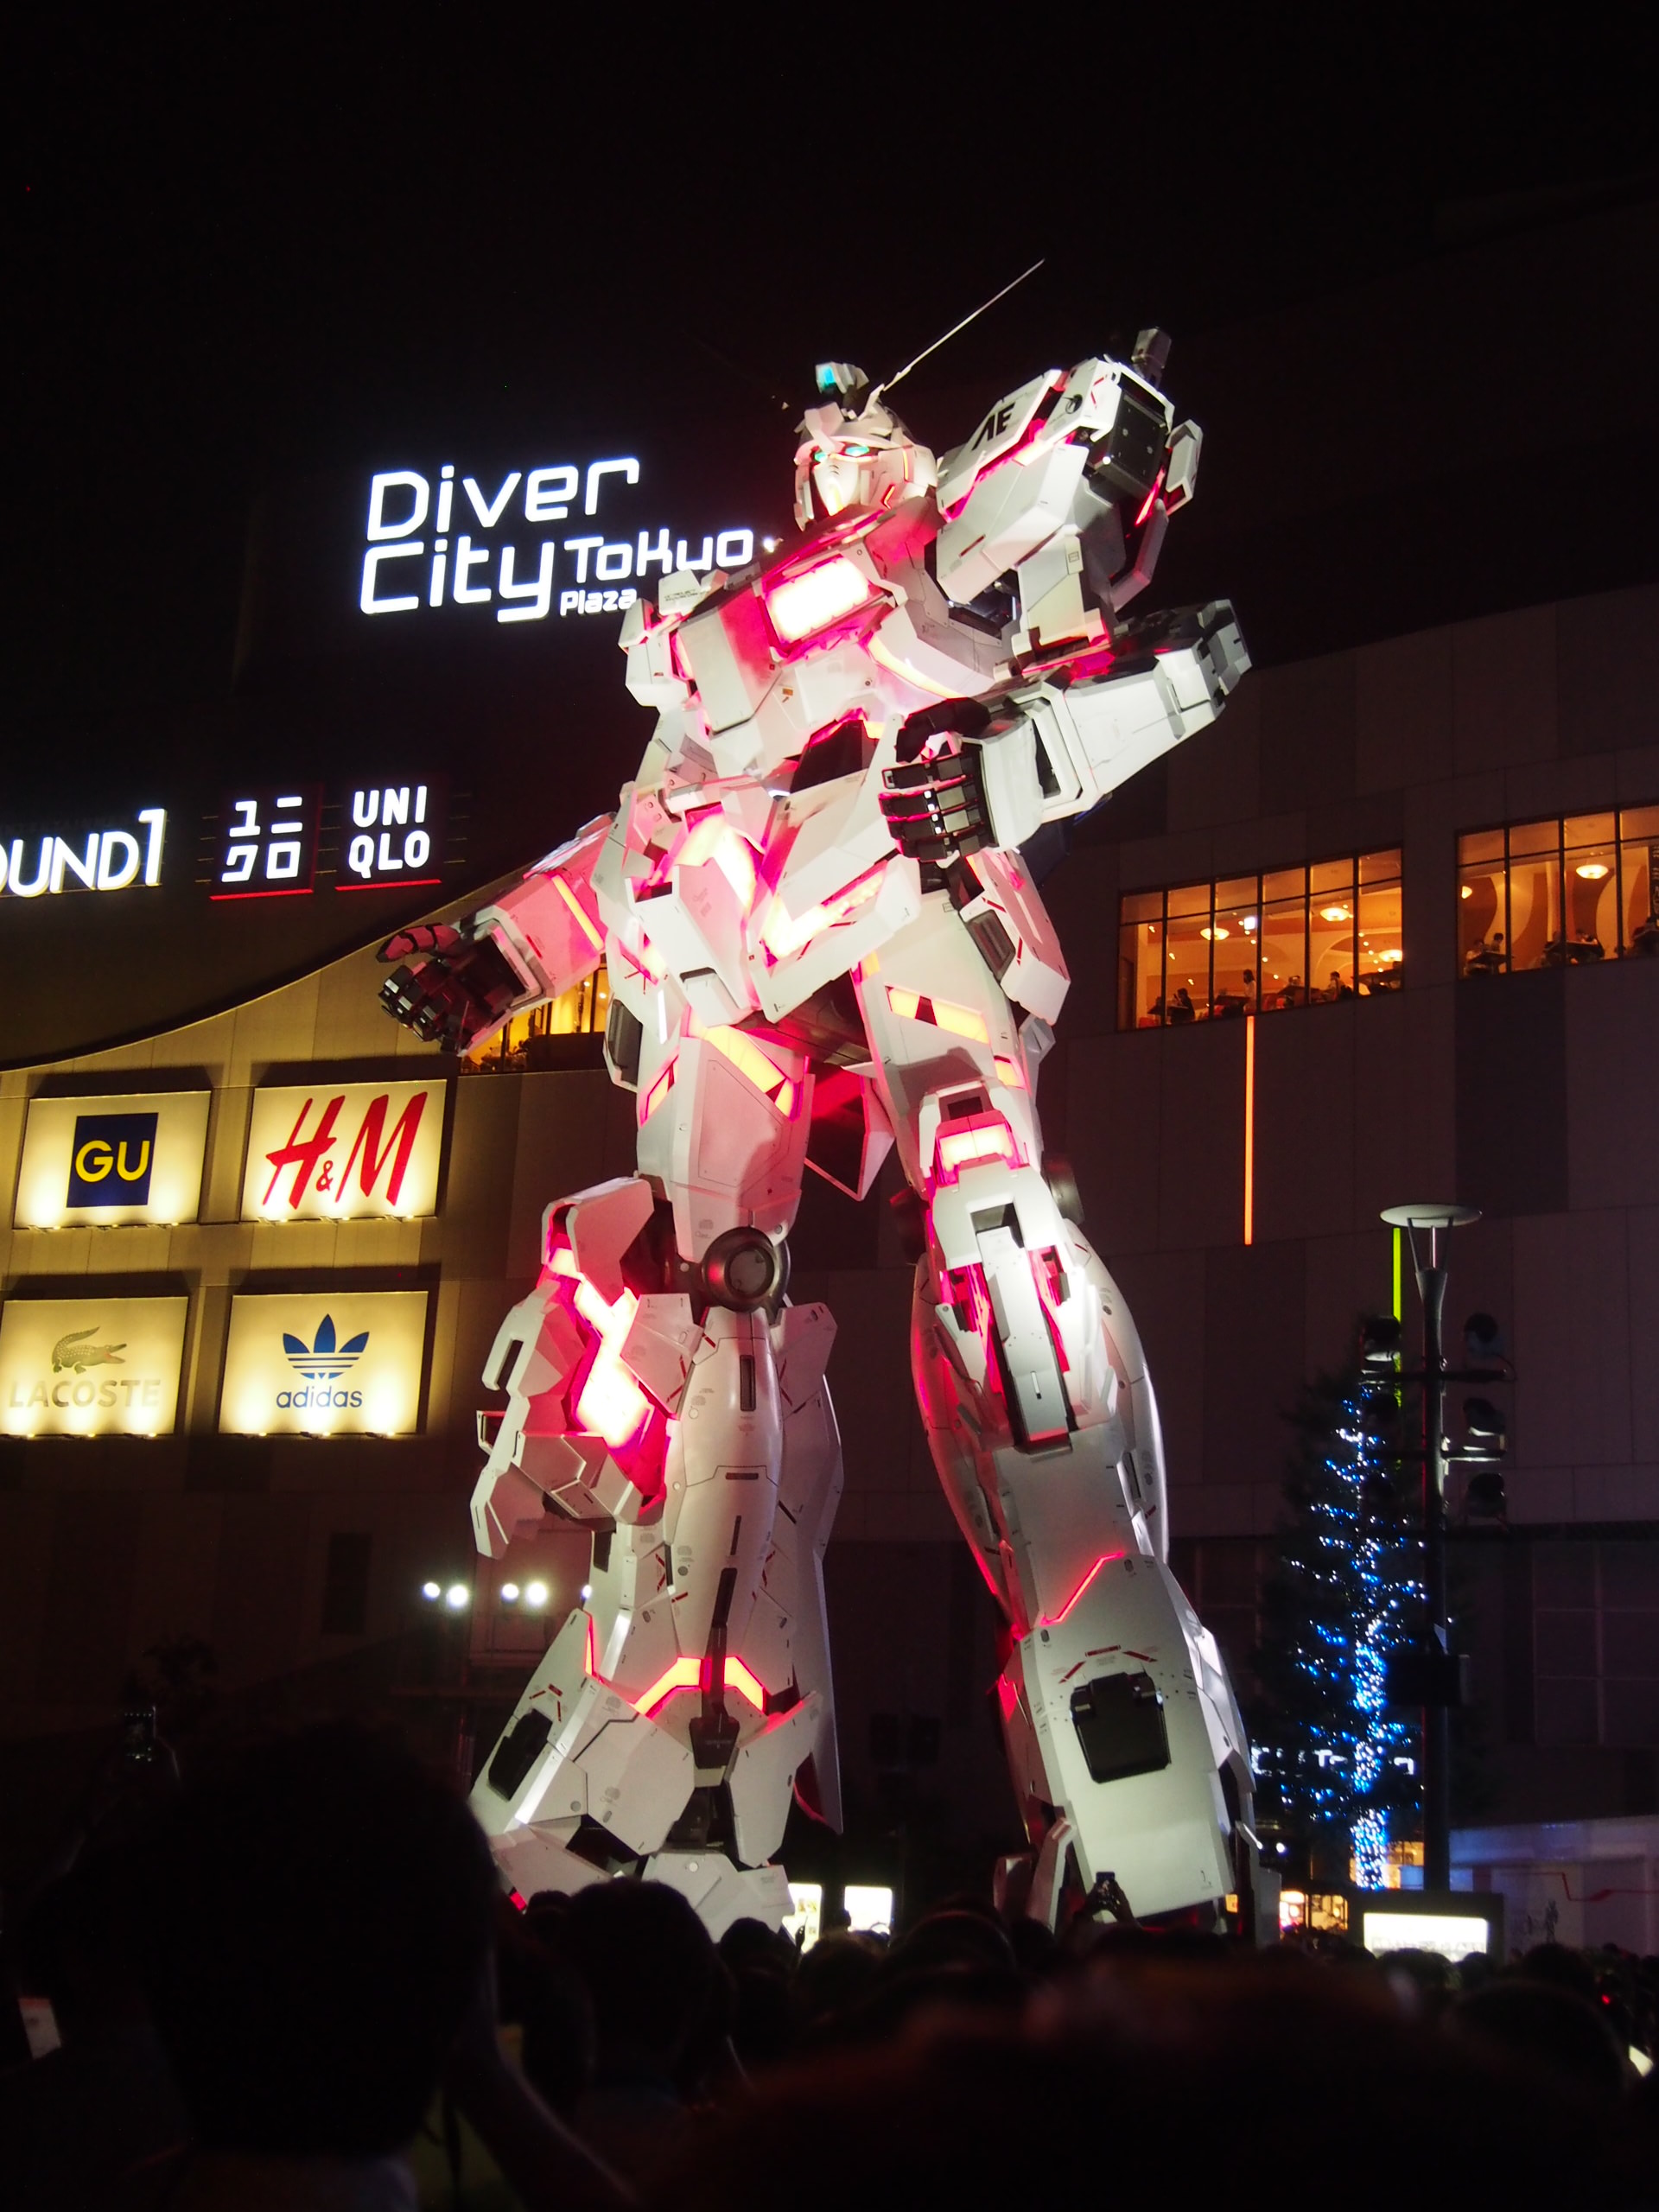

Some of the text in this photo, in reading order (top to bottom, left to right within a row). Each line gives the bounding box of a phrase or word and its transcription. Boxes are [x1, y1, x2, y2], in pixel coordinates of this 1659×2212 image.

[366, 457, 639, 542] Diver
[359, 535, 556, 624] City
[559, 588, 637, 617] Plaza
[353, 785, 428, 828] UNI
[0, 808, 167, 898] UND1
[348, 830, 430, 879] QLO
[75, 1140, 150, 1183] GU
[262, 1091, 429, 1210] H&M
[9, 1379, 162, 1408] LACOSTE
[276, 1385, 363, 1409] adidas
